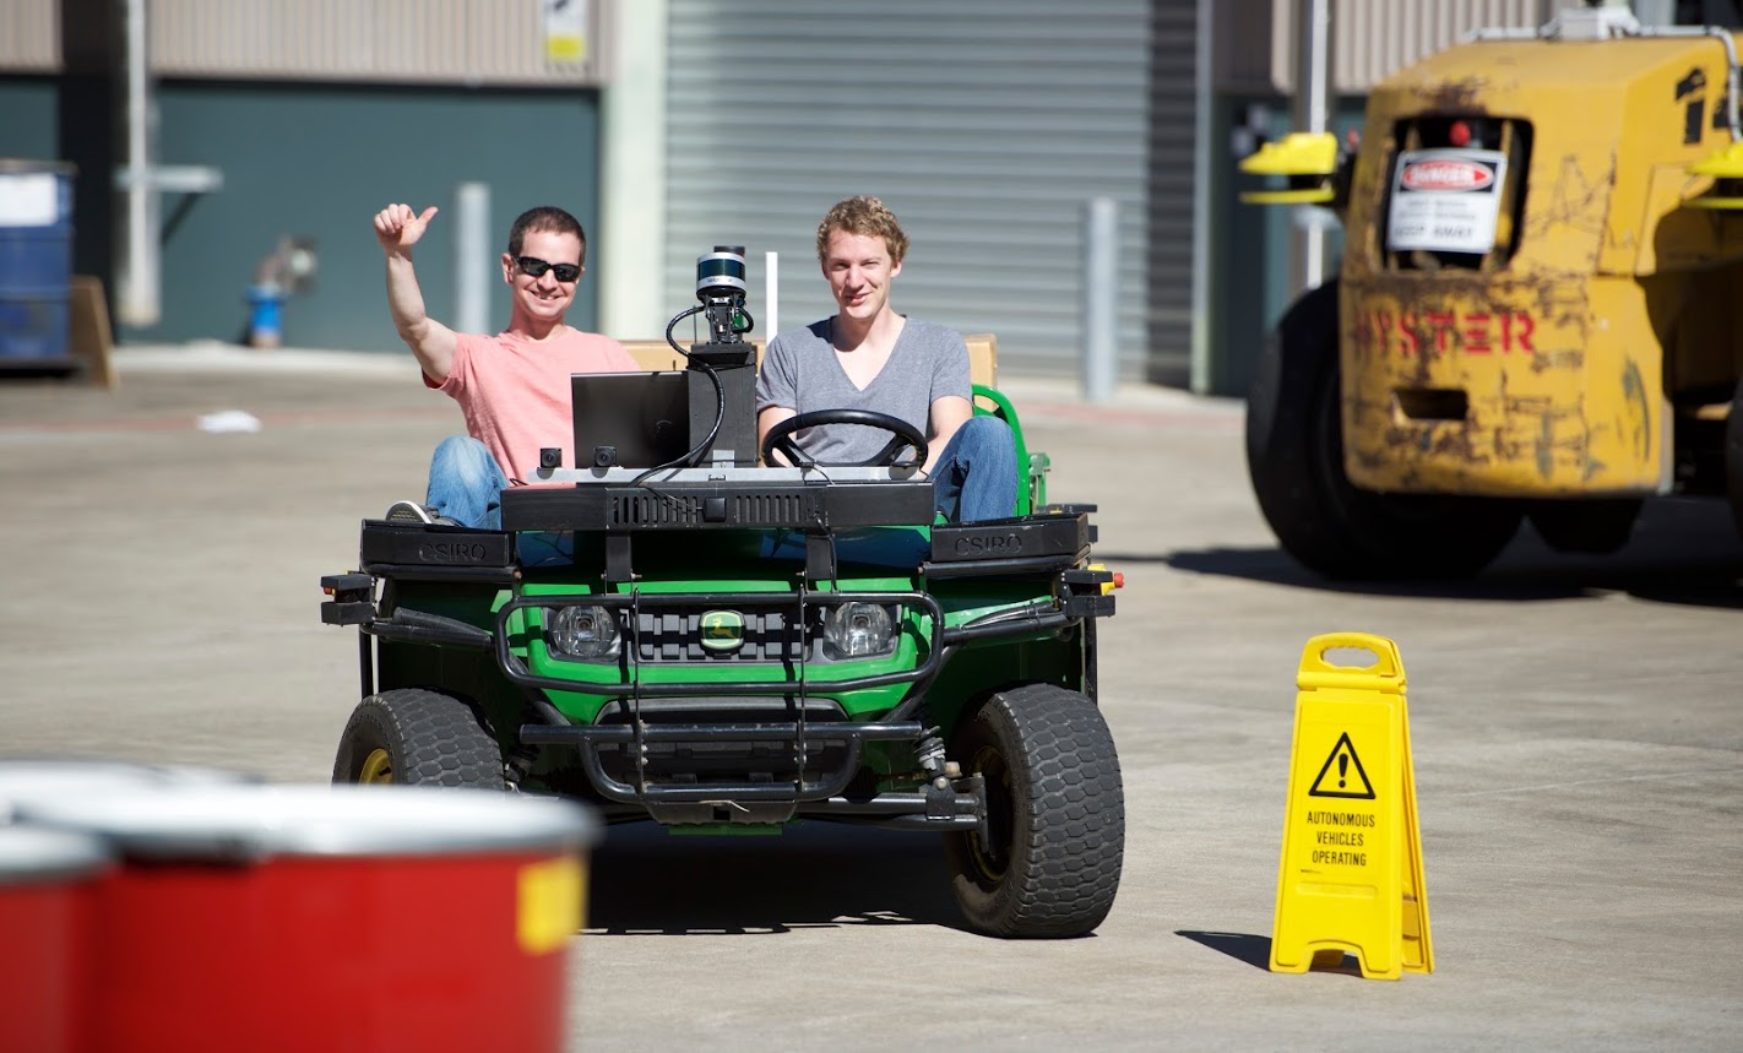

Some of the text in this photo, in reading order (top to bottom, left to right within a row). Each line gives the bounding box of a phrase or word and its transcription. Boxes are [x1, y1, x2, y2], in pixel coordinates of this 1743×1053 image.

[1351, 310, 1535, 353] YSTER
[418, 543, 486, 562] CSIRO
[956, 534, 1022, 556] CSIRO
[1307, 811, 1375, 828] AUTONOMOUS
[1317, 831, 1364, 847] VEHICLES
[1312, 850, 1367, 867] OPERATING
